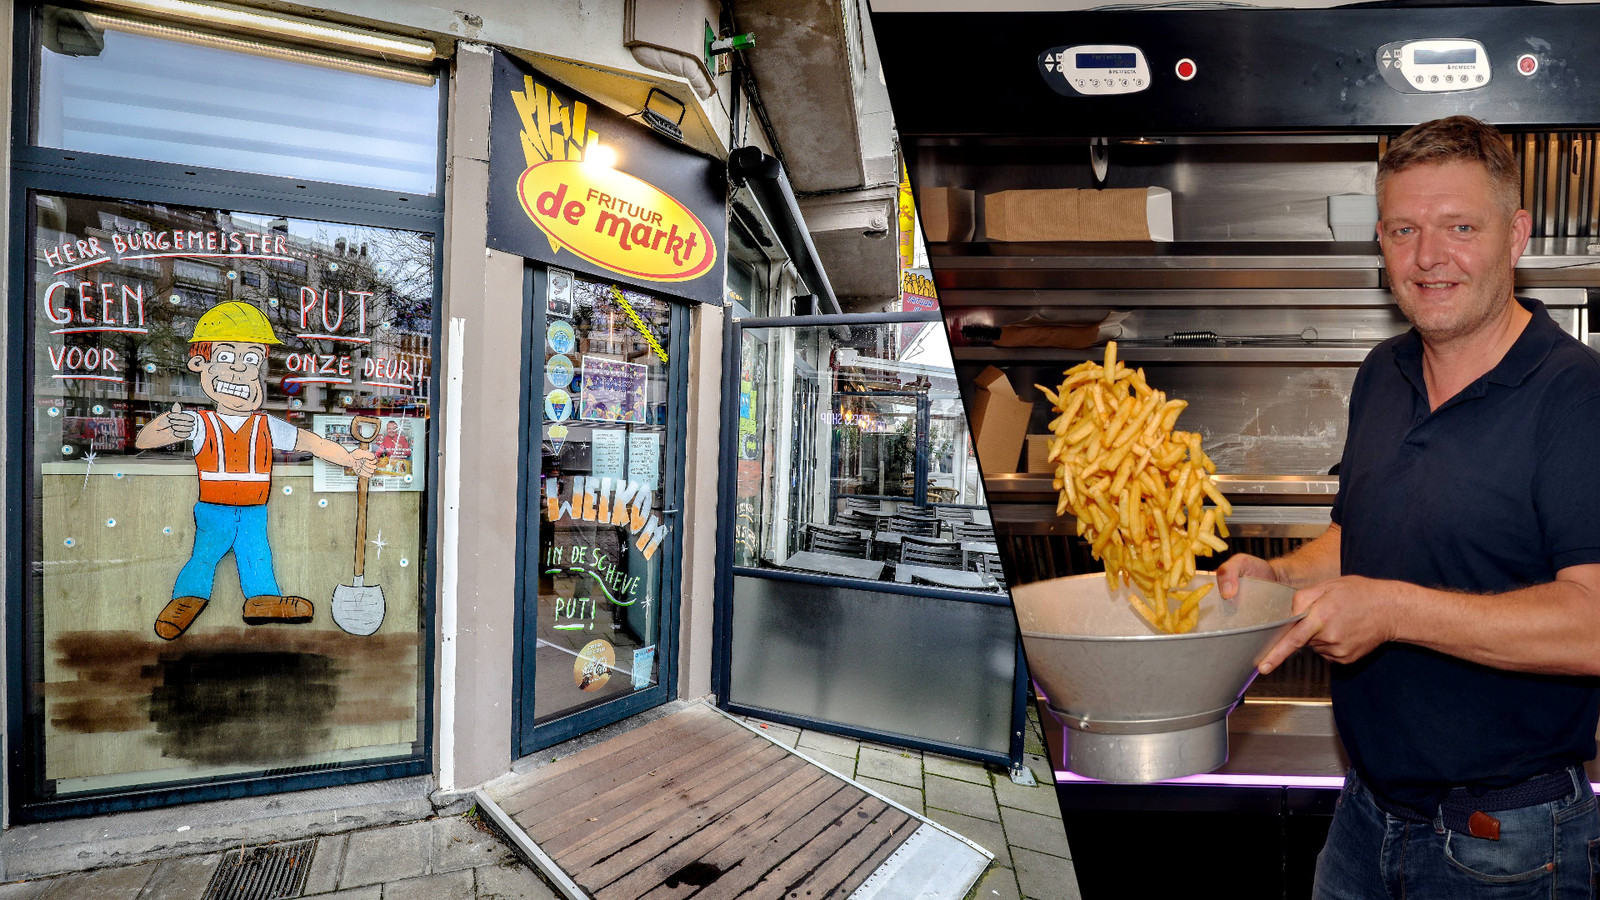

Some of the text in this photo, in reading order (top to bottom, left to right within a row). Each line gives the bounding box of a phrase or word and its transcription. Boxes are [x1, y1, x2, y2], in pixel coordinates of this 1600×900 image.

[536, 183, 698, 266] de markt
[586, 187, 663, 227] FRITUUR
[44, 236, 106, 268] HERR
[44, 281, 373, 334] GEEN PUT
[48, 346, 425, 387] VOOR ONZE DEUR!
[546, 475, 668, 561] WELKOM
[571, 545, 588, 565] DE
[590, 548, 641, 595] SCHEVE
[554, 597, 597, 631] PUT!
